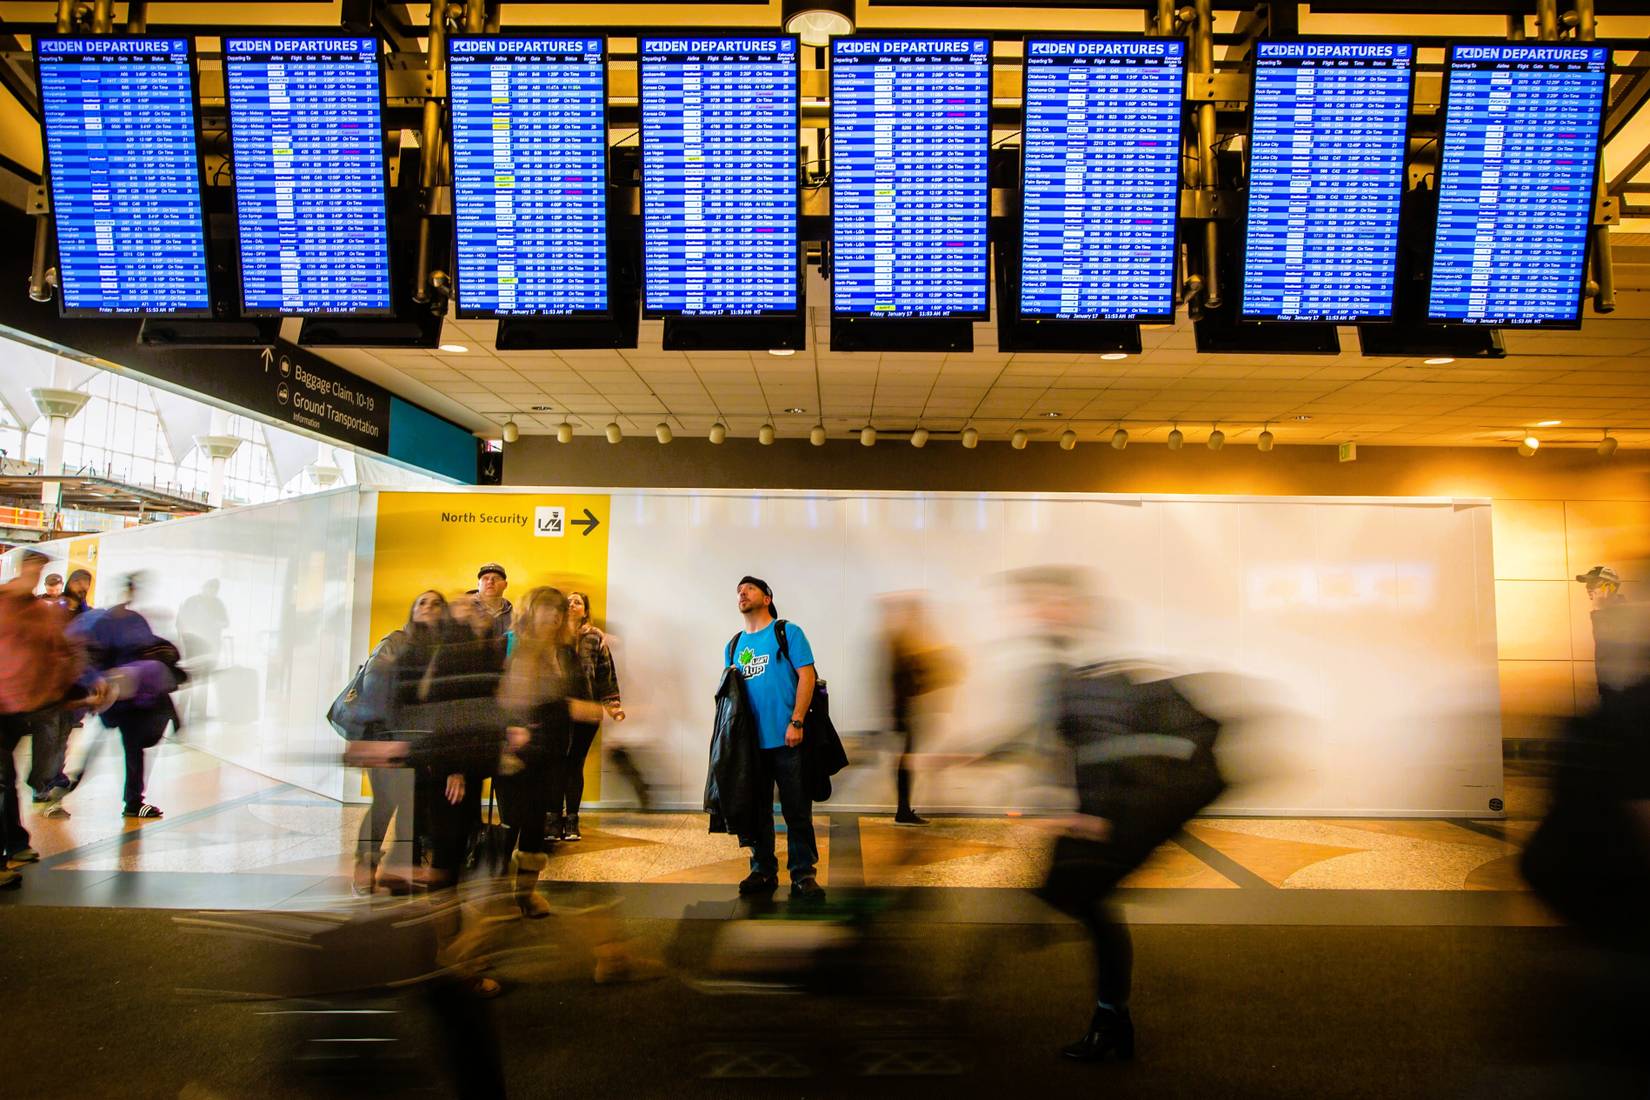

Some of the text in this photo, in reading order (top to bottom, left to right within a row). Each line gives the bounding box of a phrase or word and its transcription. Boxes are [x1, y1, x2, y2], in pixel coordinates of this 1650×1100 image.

[58, 41, 169, 51] DEN DEPARTURES
[247, 41, 358, 51] DEN DEPARTURES
[471, 41, 583, 52] DEN DEPARTURES
[663, 41, 777, 51] DEN DEPARTURES
[855, 42, 969, 52] DEN DEPARTURES
[1050, 43, 1164, 54] DEN DEPARTURES
[1278, 45, 1392, 56] DEN DEPARTURES
[1474, 48, 1588, 59] DEN DEPARTURES
[295, 365, 375, 411] Baggage Claim, 10-19
[293, 392, 379, 437] Ground Transportation
[293, 412, 320, 428] Information
[441, 512, 528, 527] North Security
